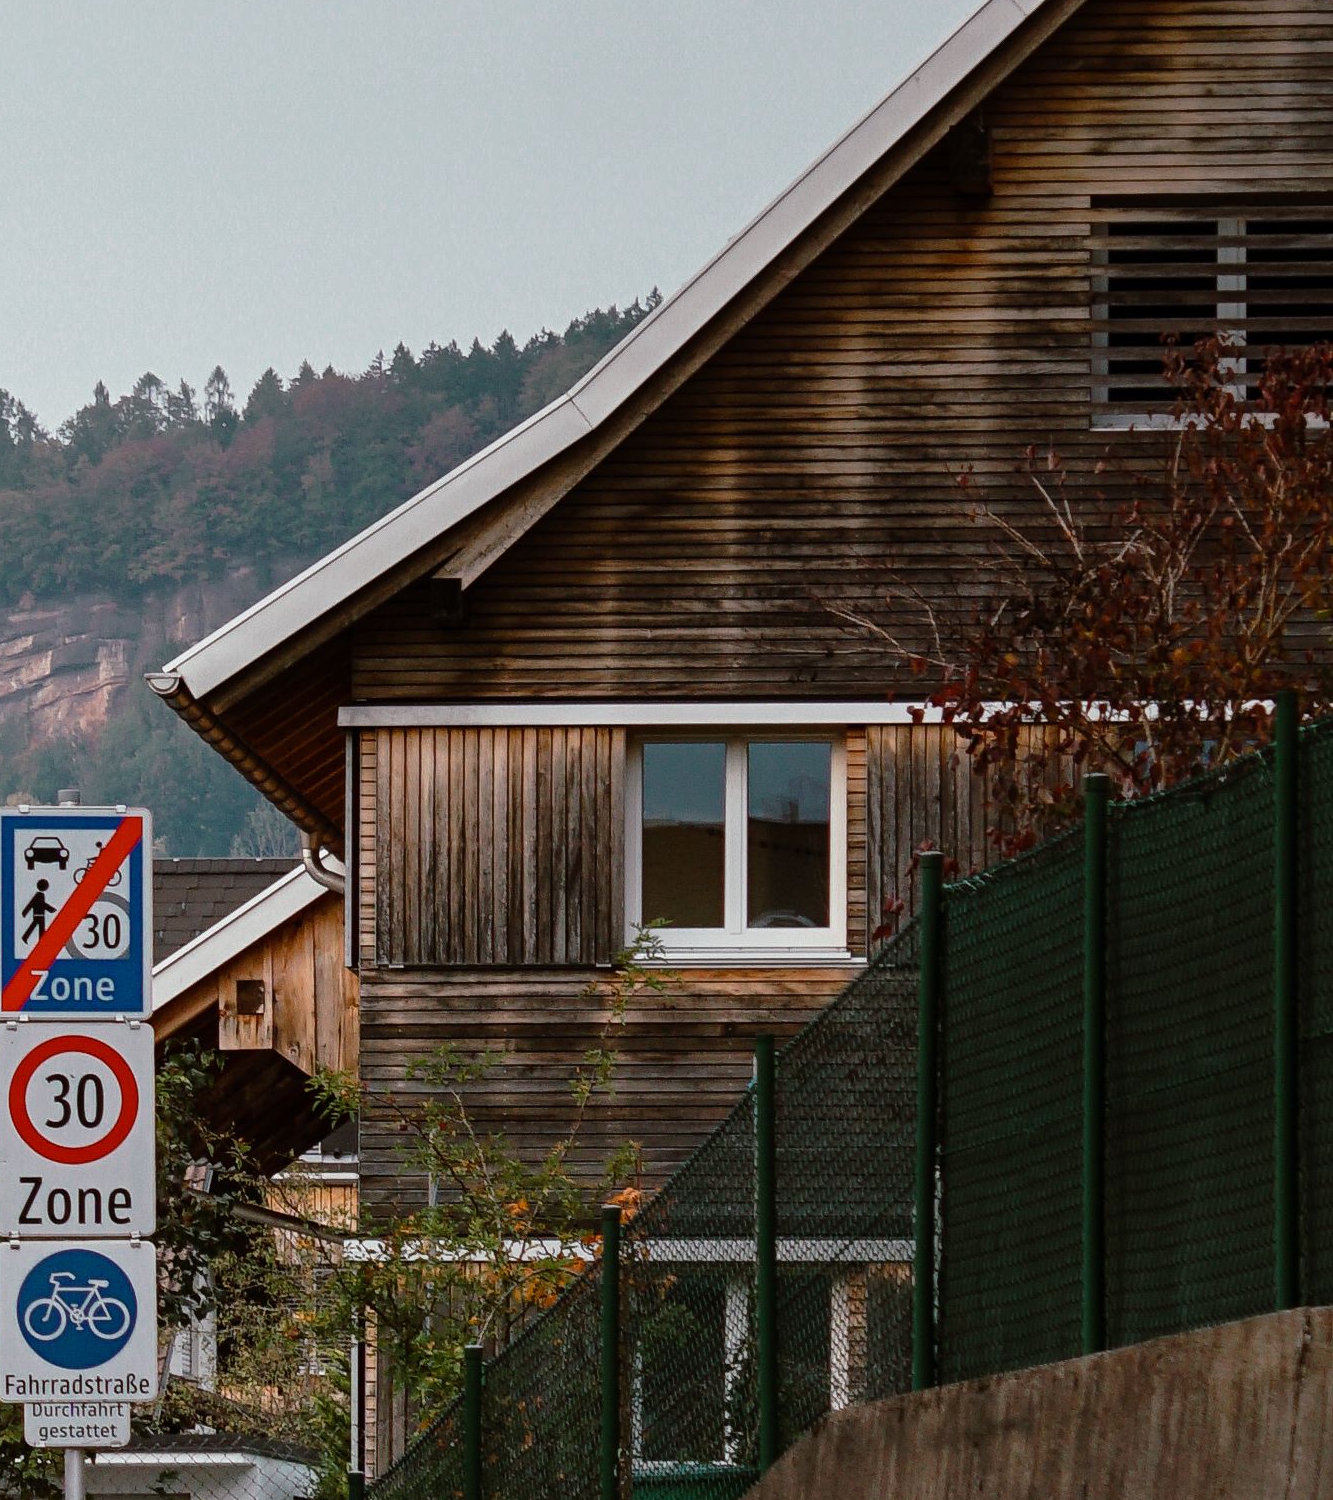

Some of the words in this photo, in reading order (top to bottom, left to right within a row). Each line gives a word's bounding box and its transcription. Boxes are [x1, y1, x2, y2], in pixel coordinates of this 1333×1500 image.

[83, 913, 121, 949] 30
[29, 970, 115, 1001] Zone
[45, 1073, 104, 1128] 30
[18, 1176, 132, 1225] Zone
[5, 1374, 150, 1395] Fahrradstraße
[33, 1402, 125, 1417] Durchfahrt
[39, 1424, 118, 1441] gestattet
